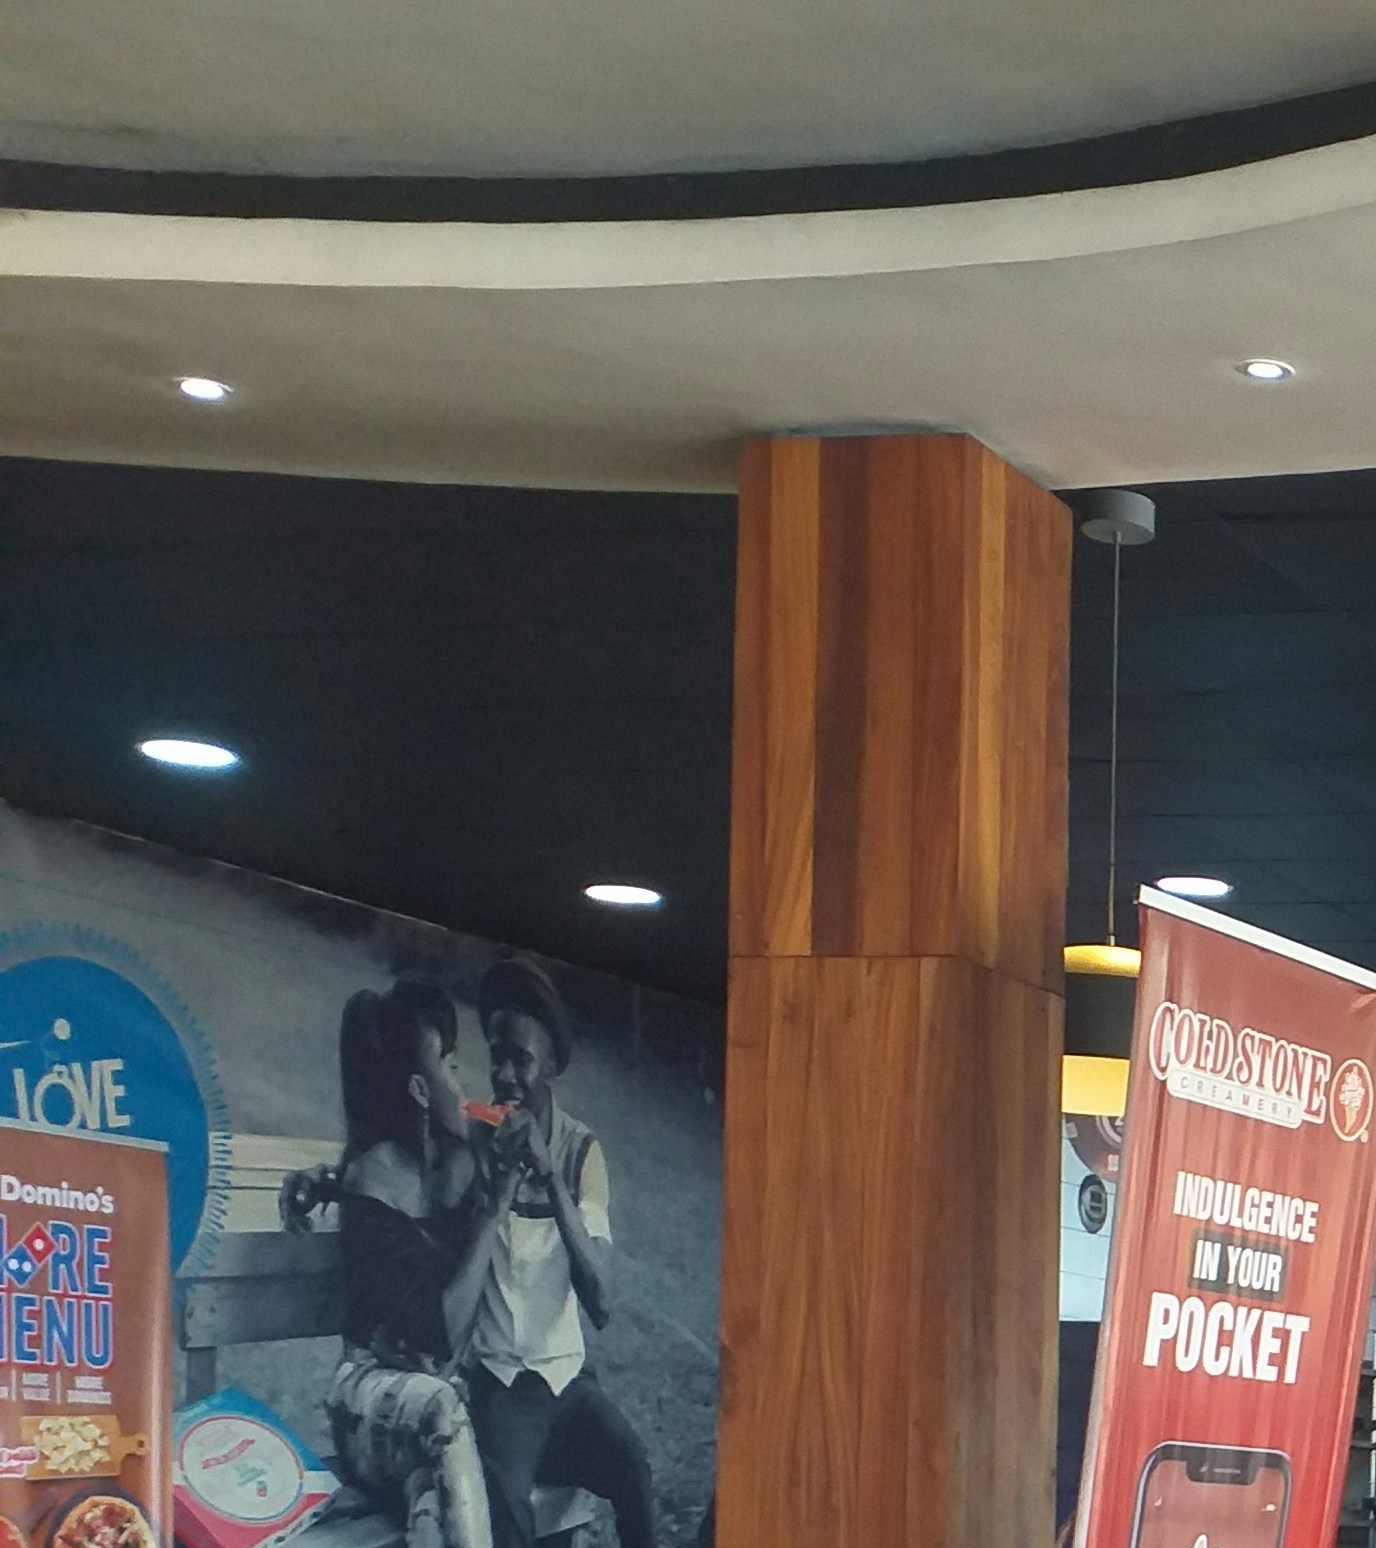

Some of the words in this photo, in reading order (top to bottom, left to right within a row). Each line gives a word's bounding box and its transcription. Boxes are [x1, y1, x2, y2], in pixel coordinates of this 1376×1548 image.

[1150, 1002, 1233, 1080] COLD
[1233, 1028, 1331, 1124] STONE
[1180, 1075, 1294, 1119] CREAMERY
[0, 1174, 115, 1214] Domino's
[1173, 1170, 1320, 1243] INDULGENCE
[1193, 1239, 1222, 1281] IN
[1226, 1245, 1283, 1293] YOUR
[0, 1291, 114, 1370] ENU
[1142, 1291, 1311, 1384] POCKET
